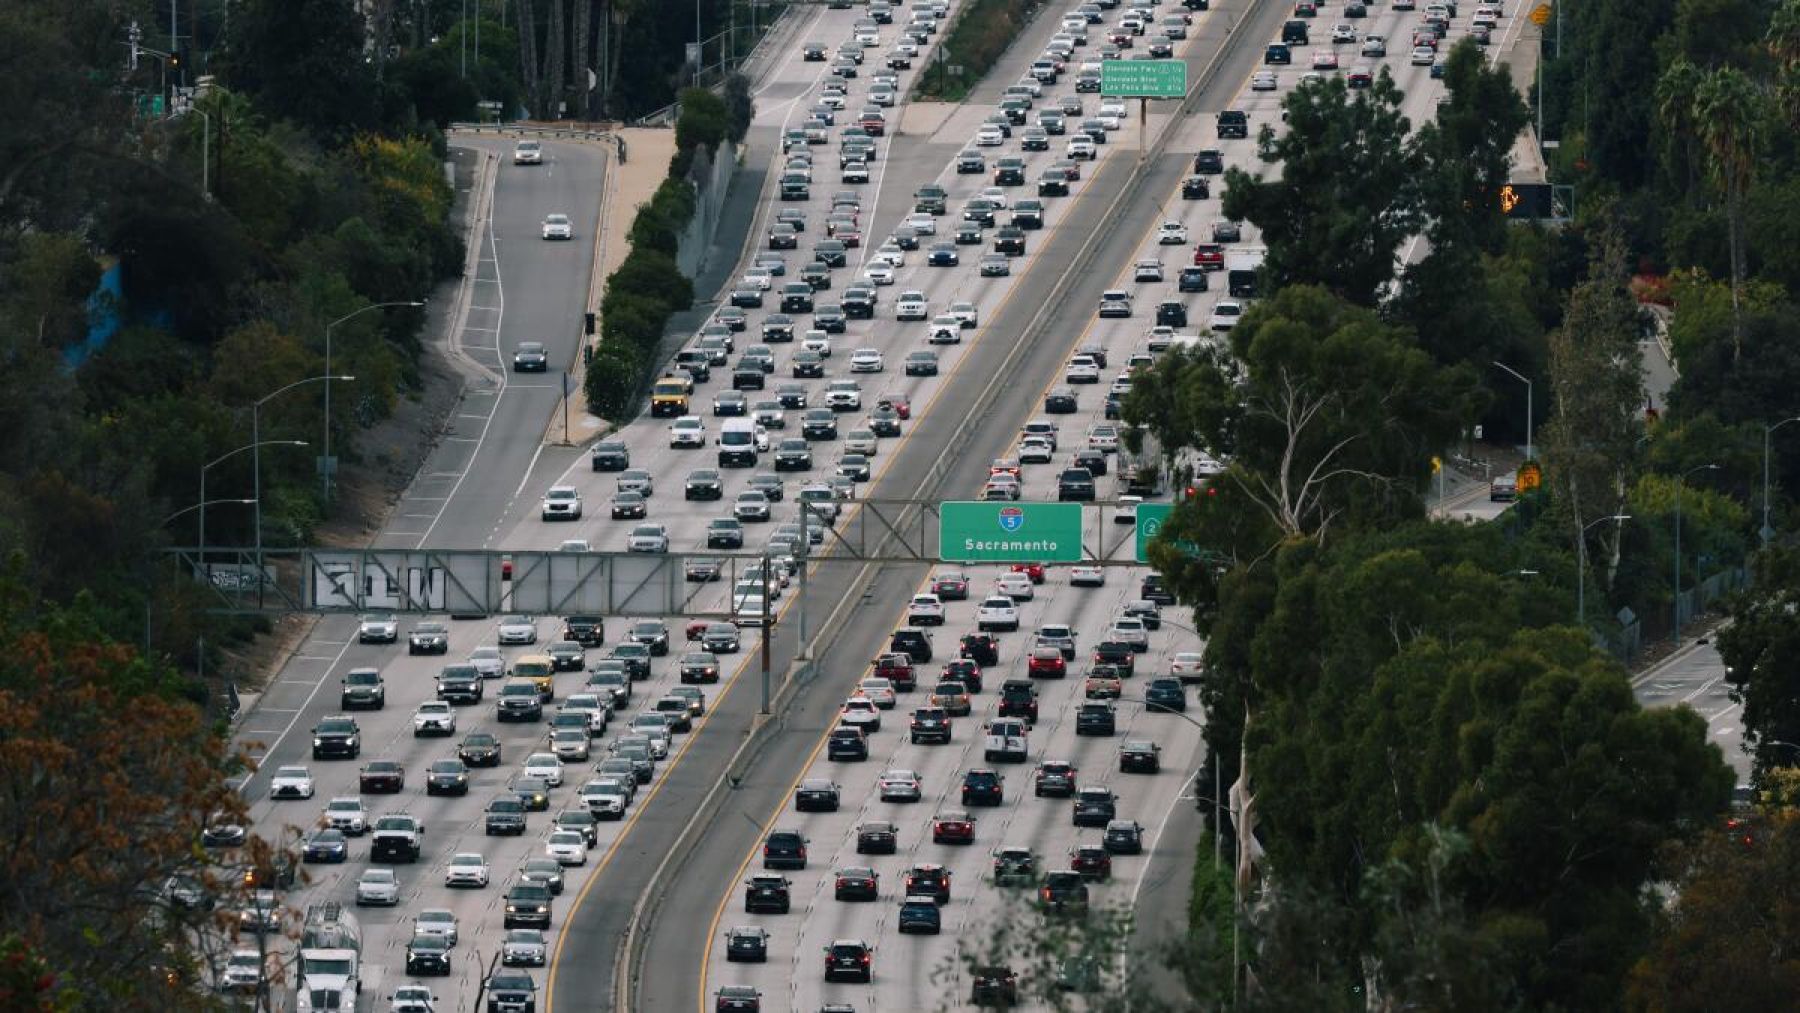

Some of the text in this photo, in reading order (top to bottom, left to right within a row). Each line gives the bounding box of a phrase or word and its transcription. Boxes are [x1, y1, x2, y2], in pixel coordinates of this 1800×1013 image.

[1141, 65, 1156, 73] Fwy
[1105, 83, 1119, 91] Los
[1007, 517, 1015, 528] 5
[965, 538, 1058, 551] Sacramento
